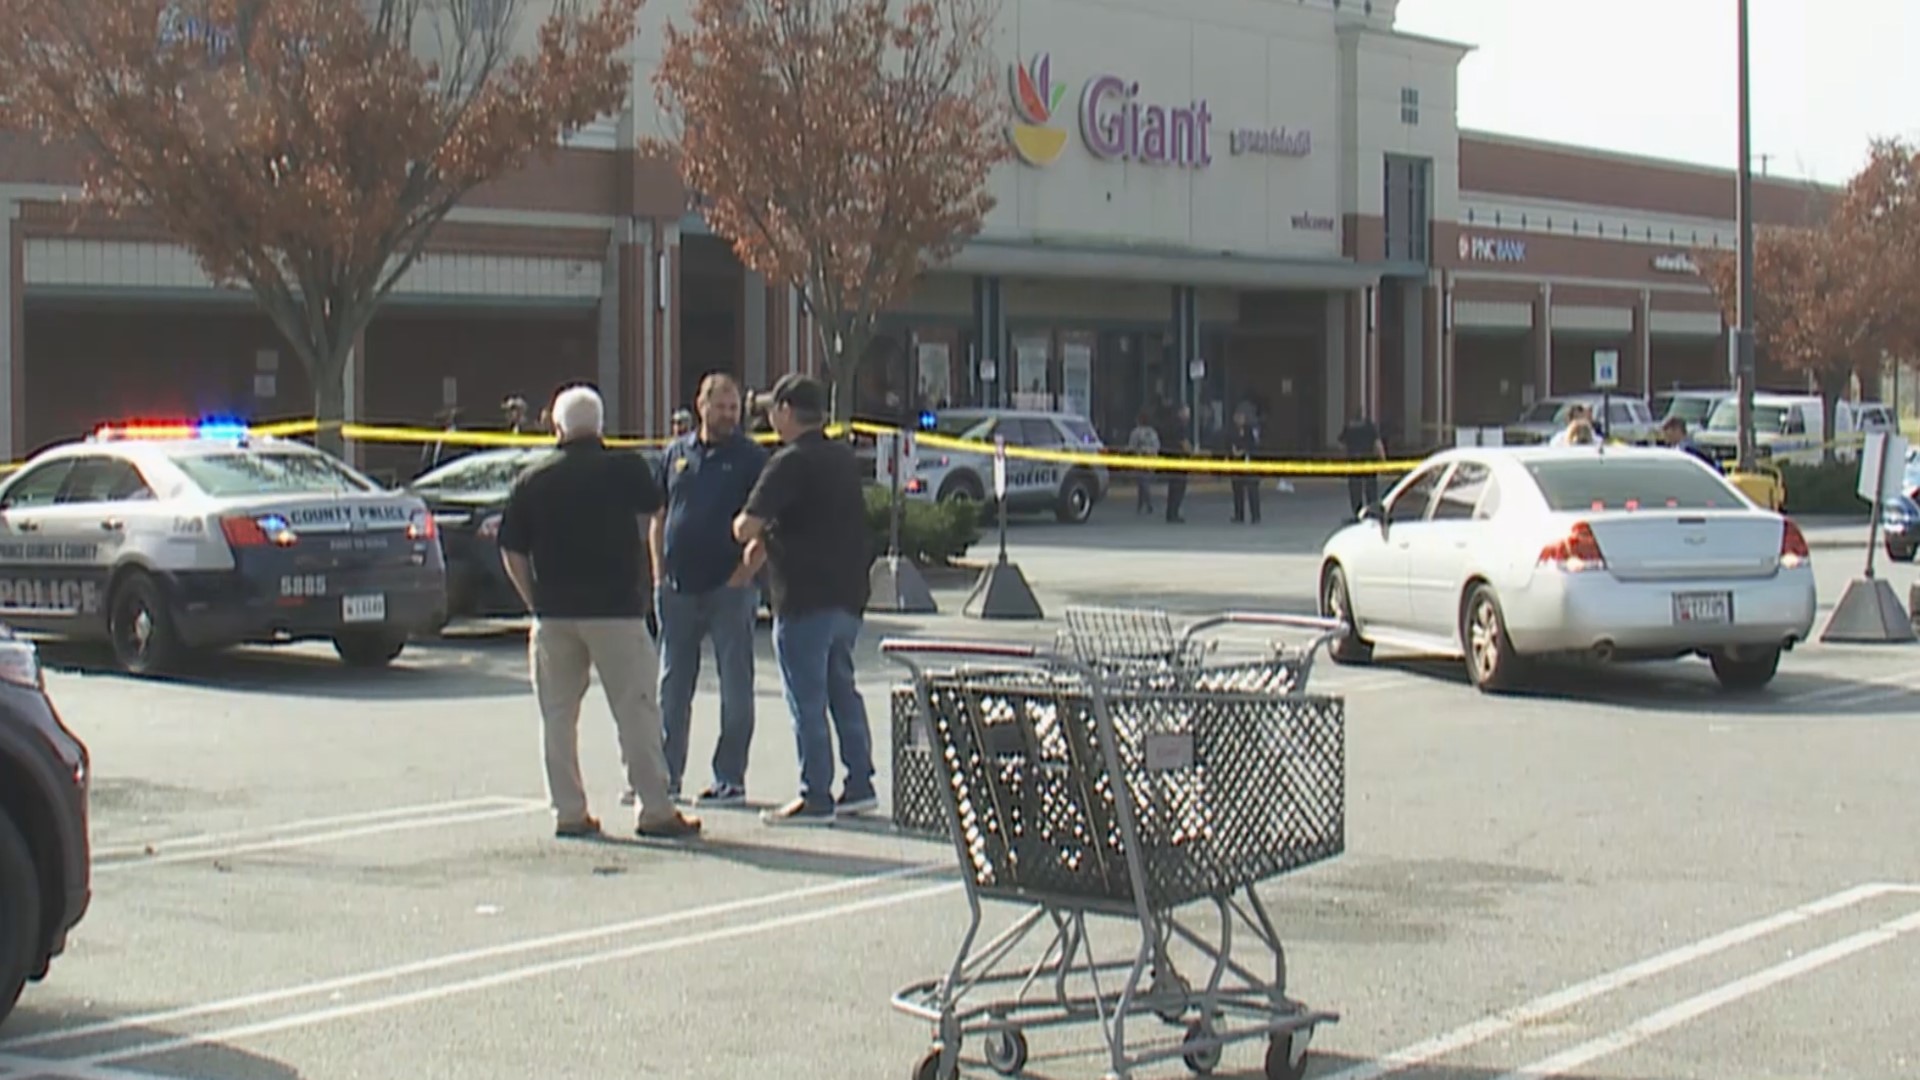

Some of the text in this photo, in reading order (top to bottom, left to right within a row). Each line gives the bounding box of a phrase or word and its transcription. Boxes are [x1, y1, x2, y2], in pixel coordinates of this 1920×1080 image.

[1078, 75, 1212, 169] Giant
[290, 505, 406, 523] COUNTY POLICE
[0, 579, 99, 613] POLICE
